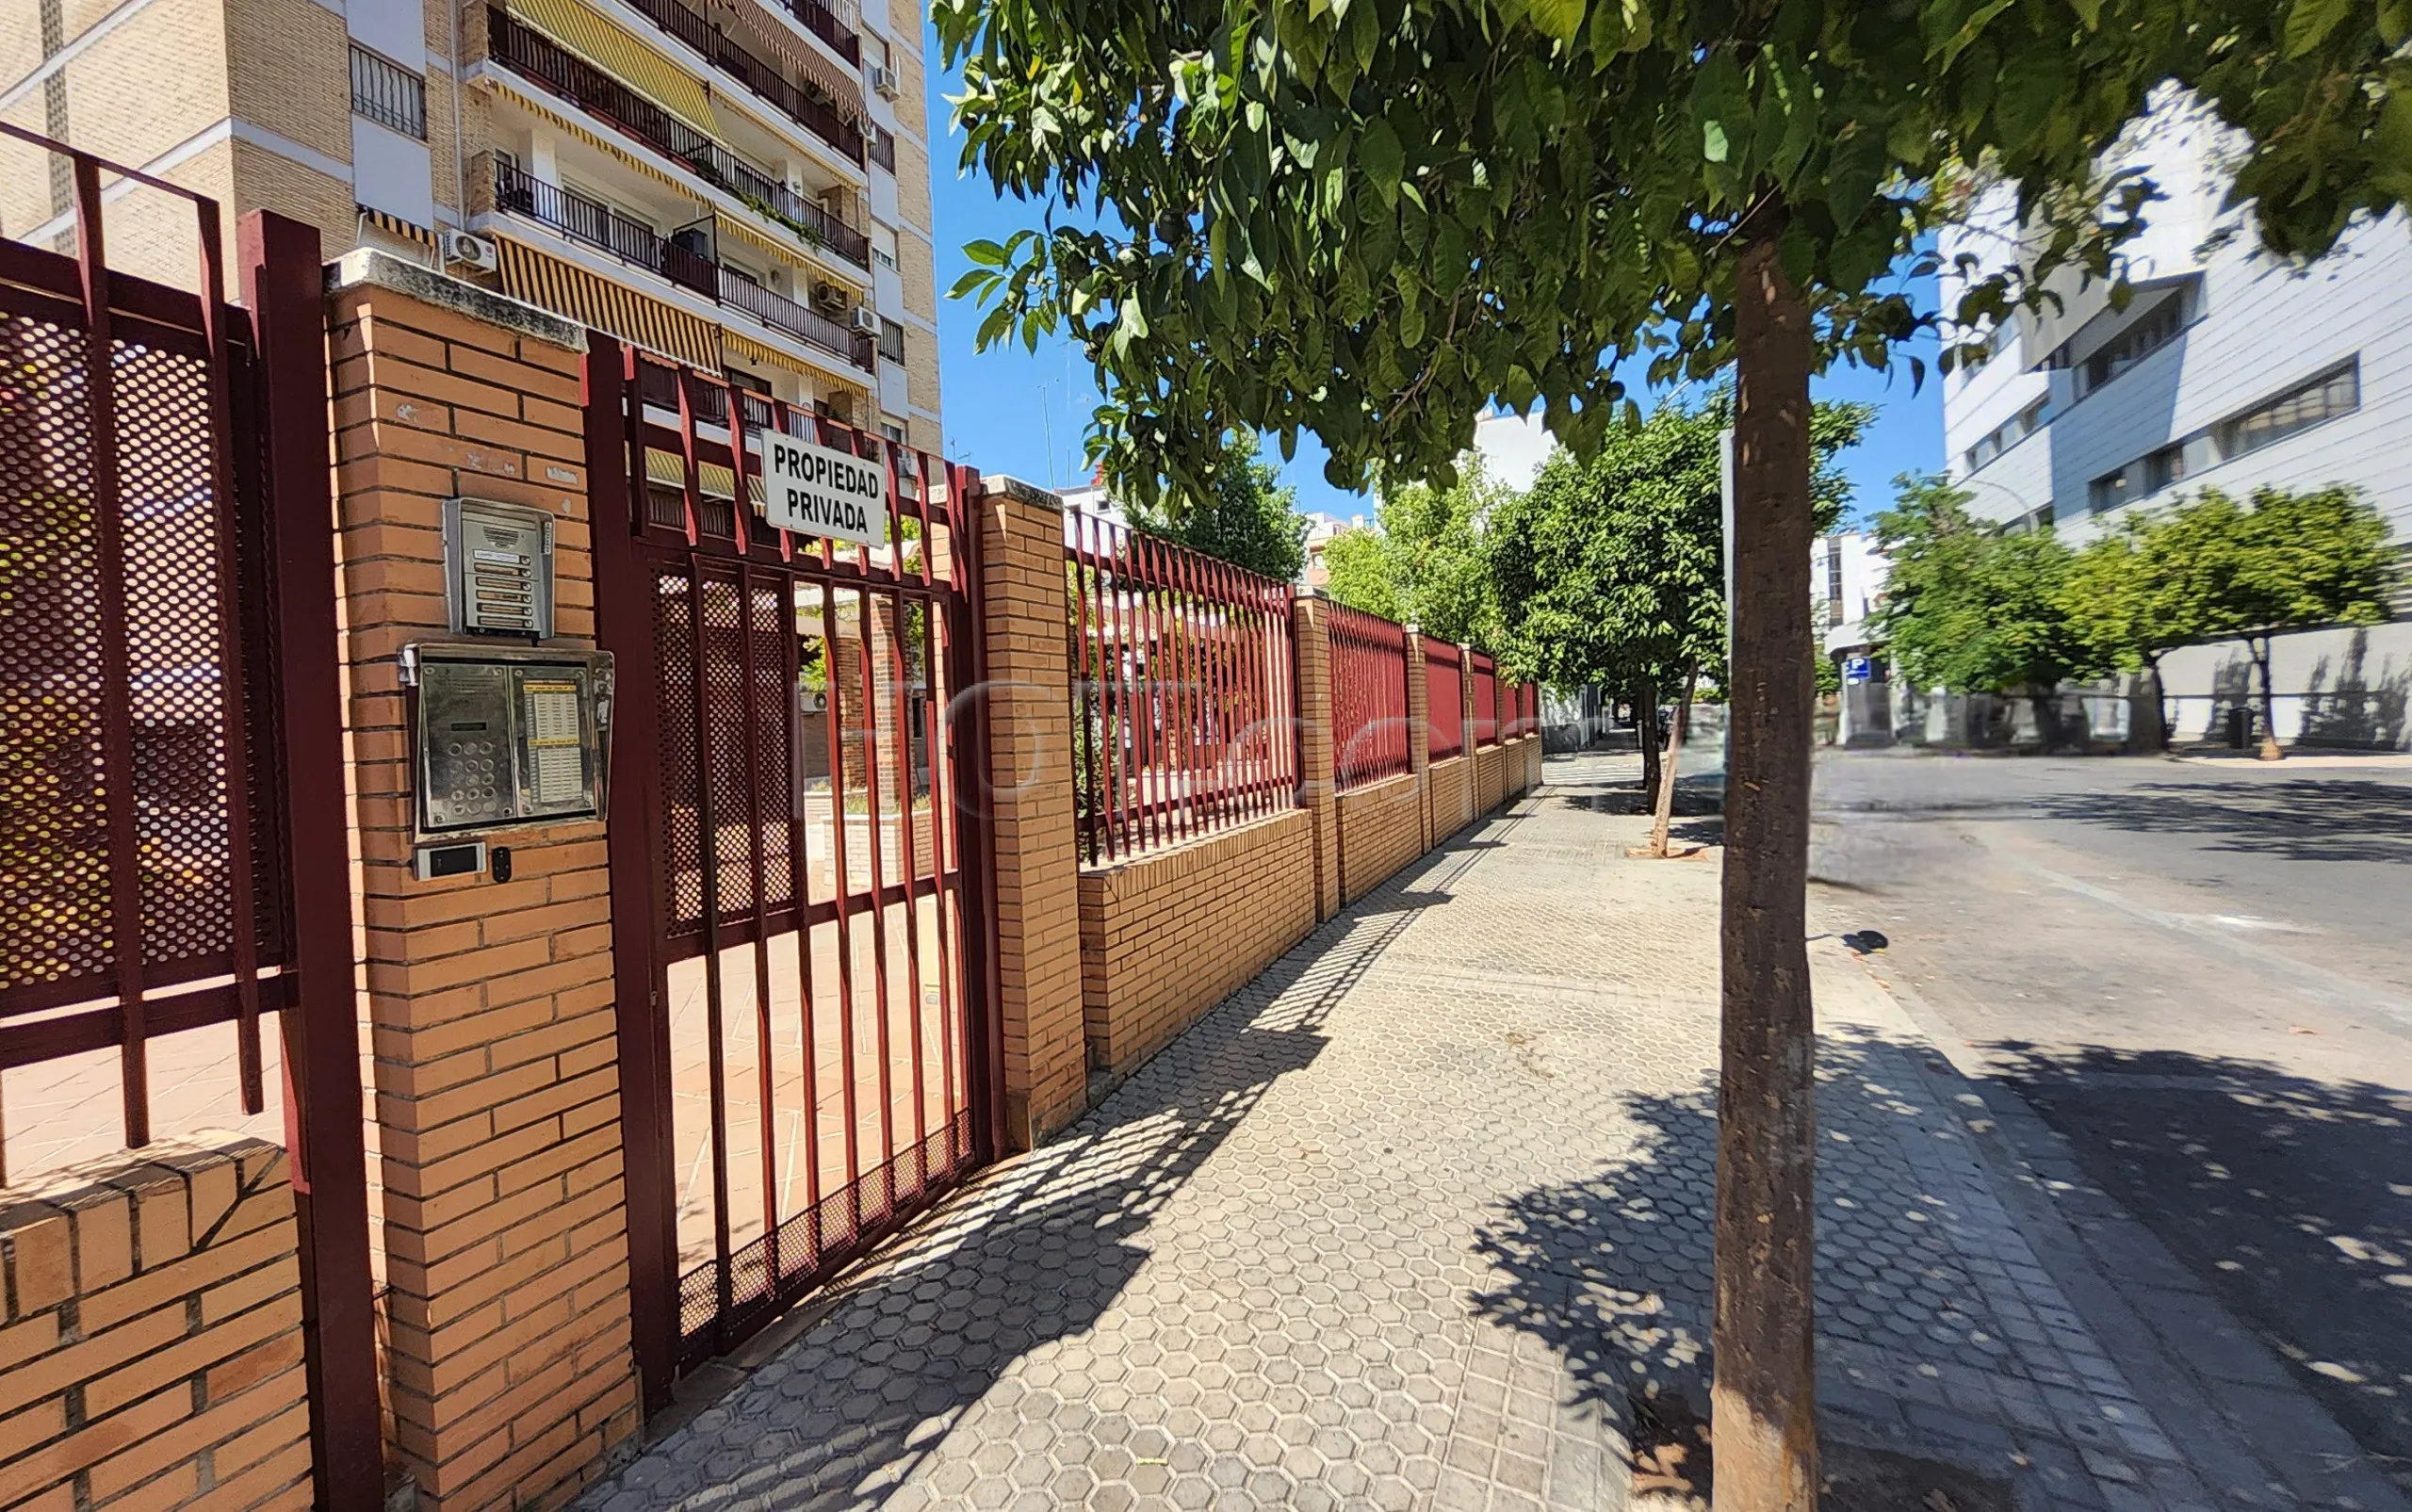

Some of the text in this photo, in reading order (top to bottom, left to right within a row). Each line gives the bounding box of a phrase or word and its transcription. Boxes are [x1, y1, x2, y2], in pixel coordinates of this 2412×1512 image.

[774, 443, 879, 499] PROPIEDAD
[787, 488, 869, 534] PRIVADA
[1851, 658, 1865, 670] P
